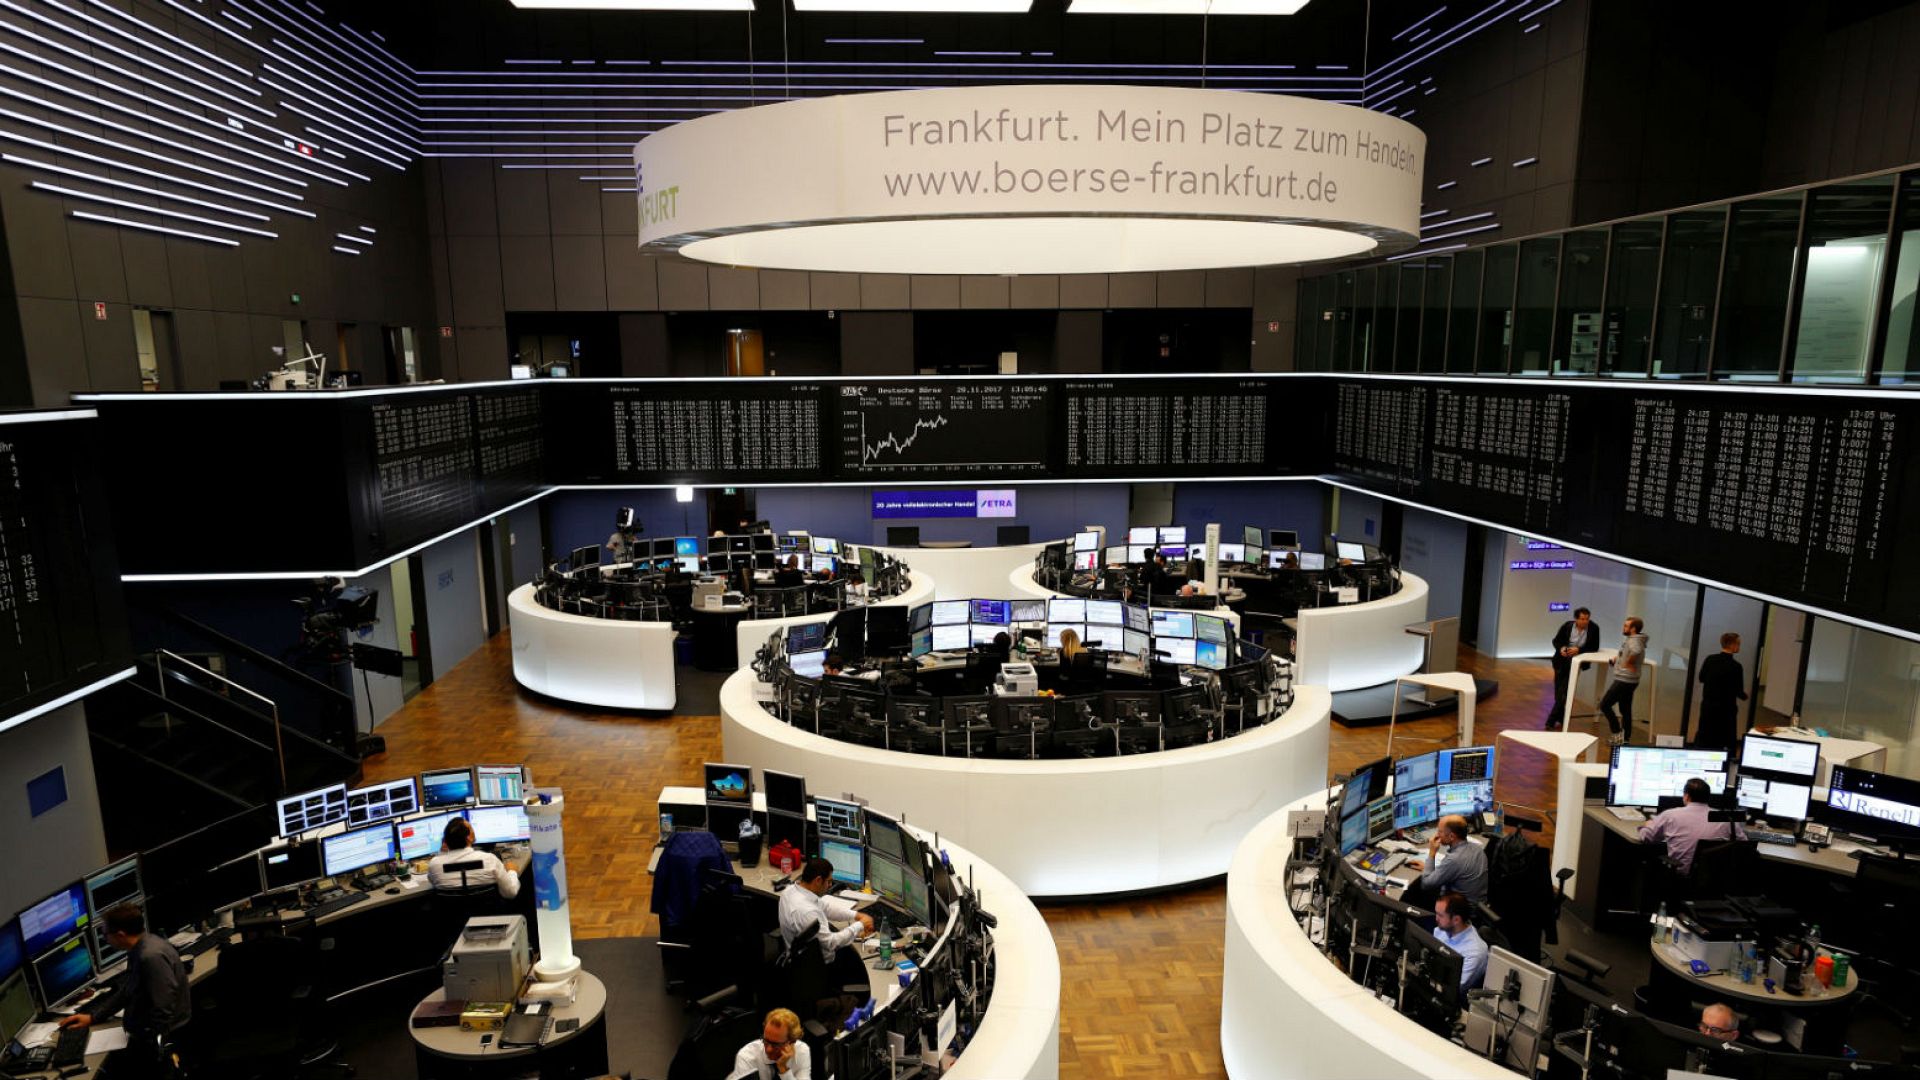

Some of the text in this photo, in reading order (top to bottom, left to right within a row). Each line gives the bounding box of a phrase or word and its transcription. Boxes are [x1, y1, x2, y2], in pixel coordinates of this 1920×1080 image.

[884, 109, 1416, 176] Frankfurt. Mein Platz zum Handeln.
[884, 161, 1338, 203] www.boerse-frankfurt.de
[20, 554, 33, 566] 32
[24, 566, 35, 578] 12
[27, 590, 39, 603] 52
[1856, 798, 1913, 824] Renell
